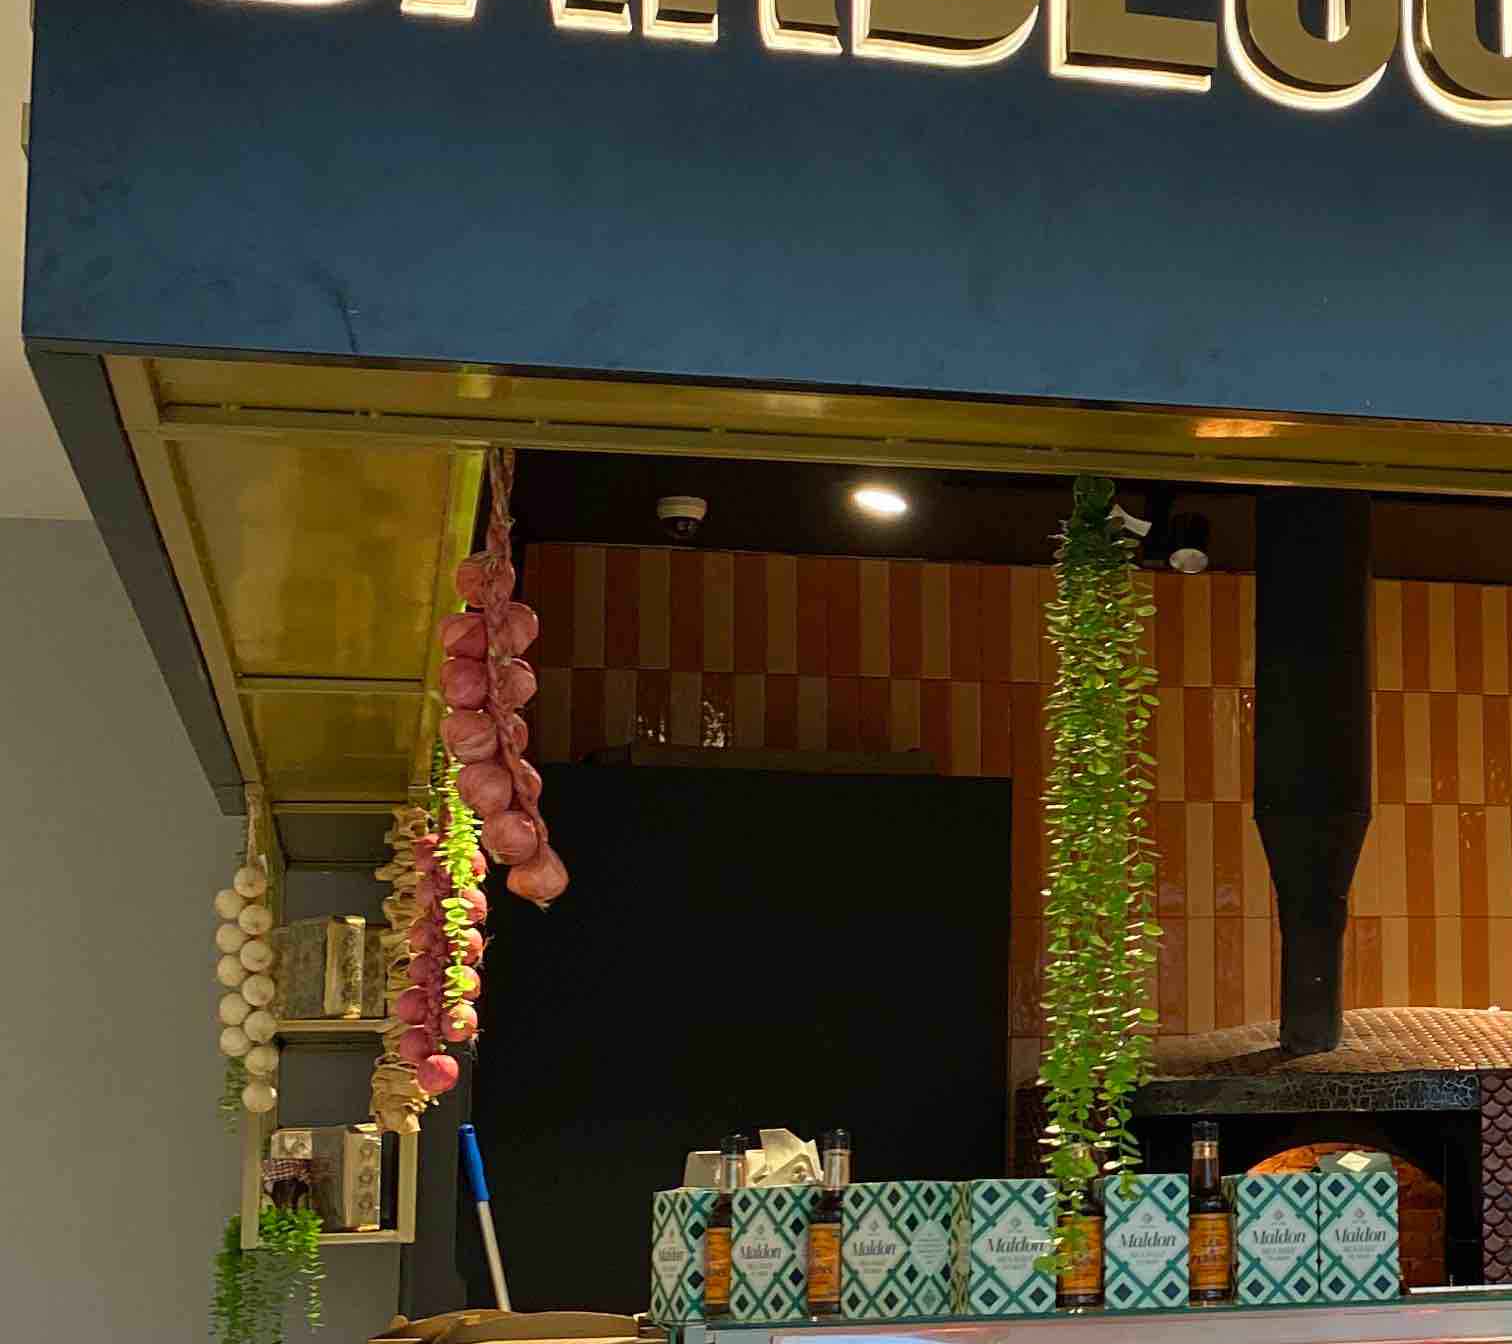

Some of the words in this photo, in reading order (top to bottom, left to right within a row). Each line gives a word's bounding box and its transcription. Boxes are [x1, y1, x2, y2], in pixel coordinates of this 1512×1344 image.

[1121, 1231, 1176, 1248] Maldon
[1252, 1228, 1307, 1245] Maldon
[1335, 1226, 1387, 1243] Maldon
[853, 1239, 897, 1257] Maldon
